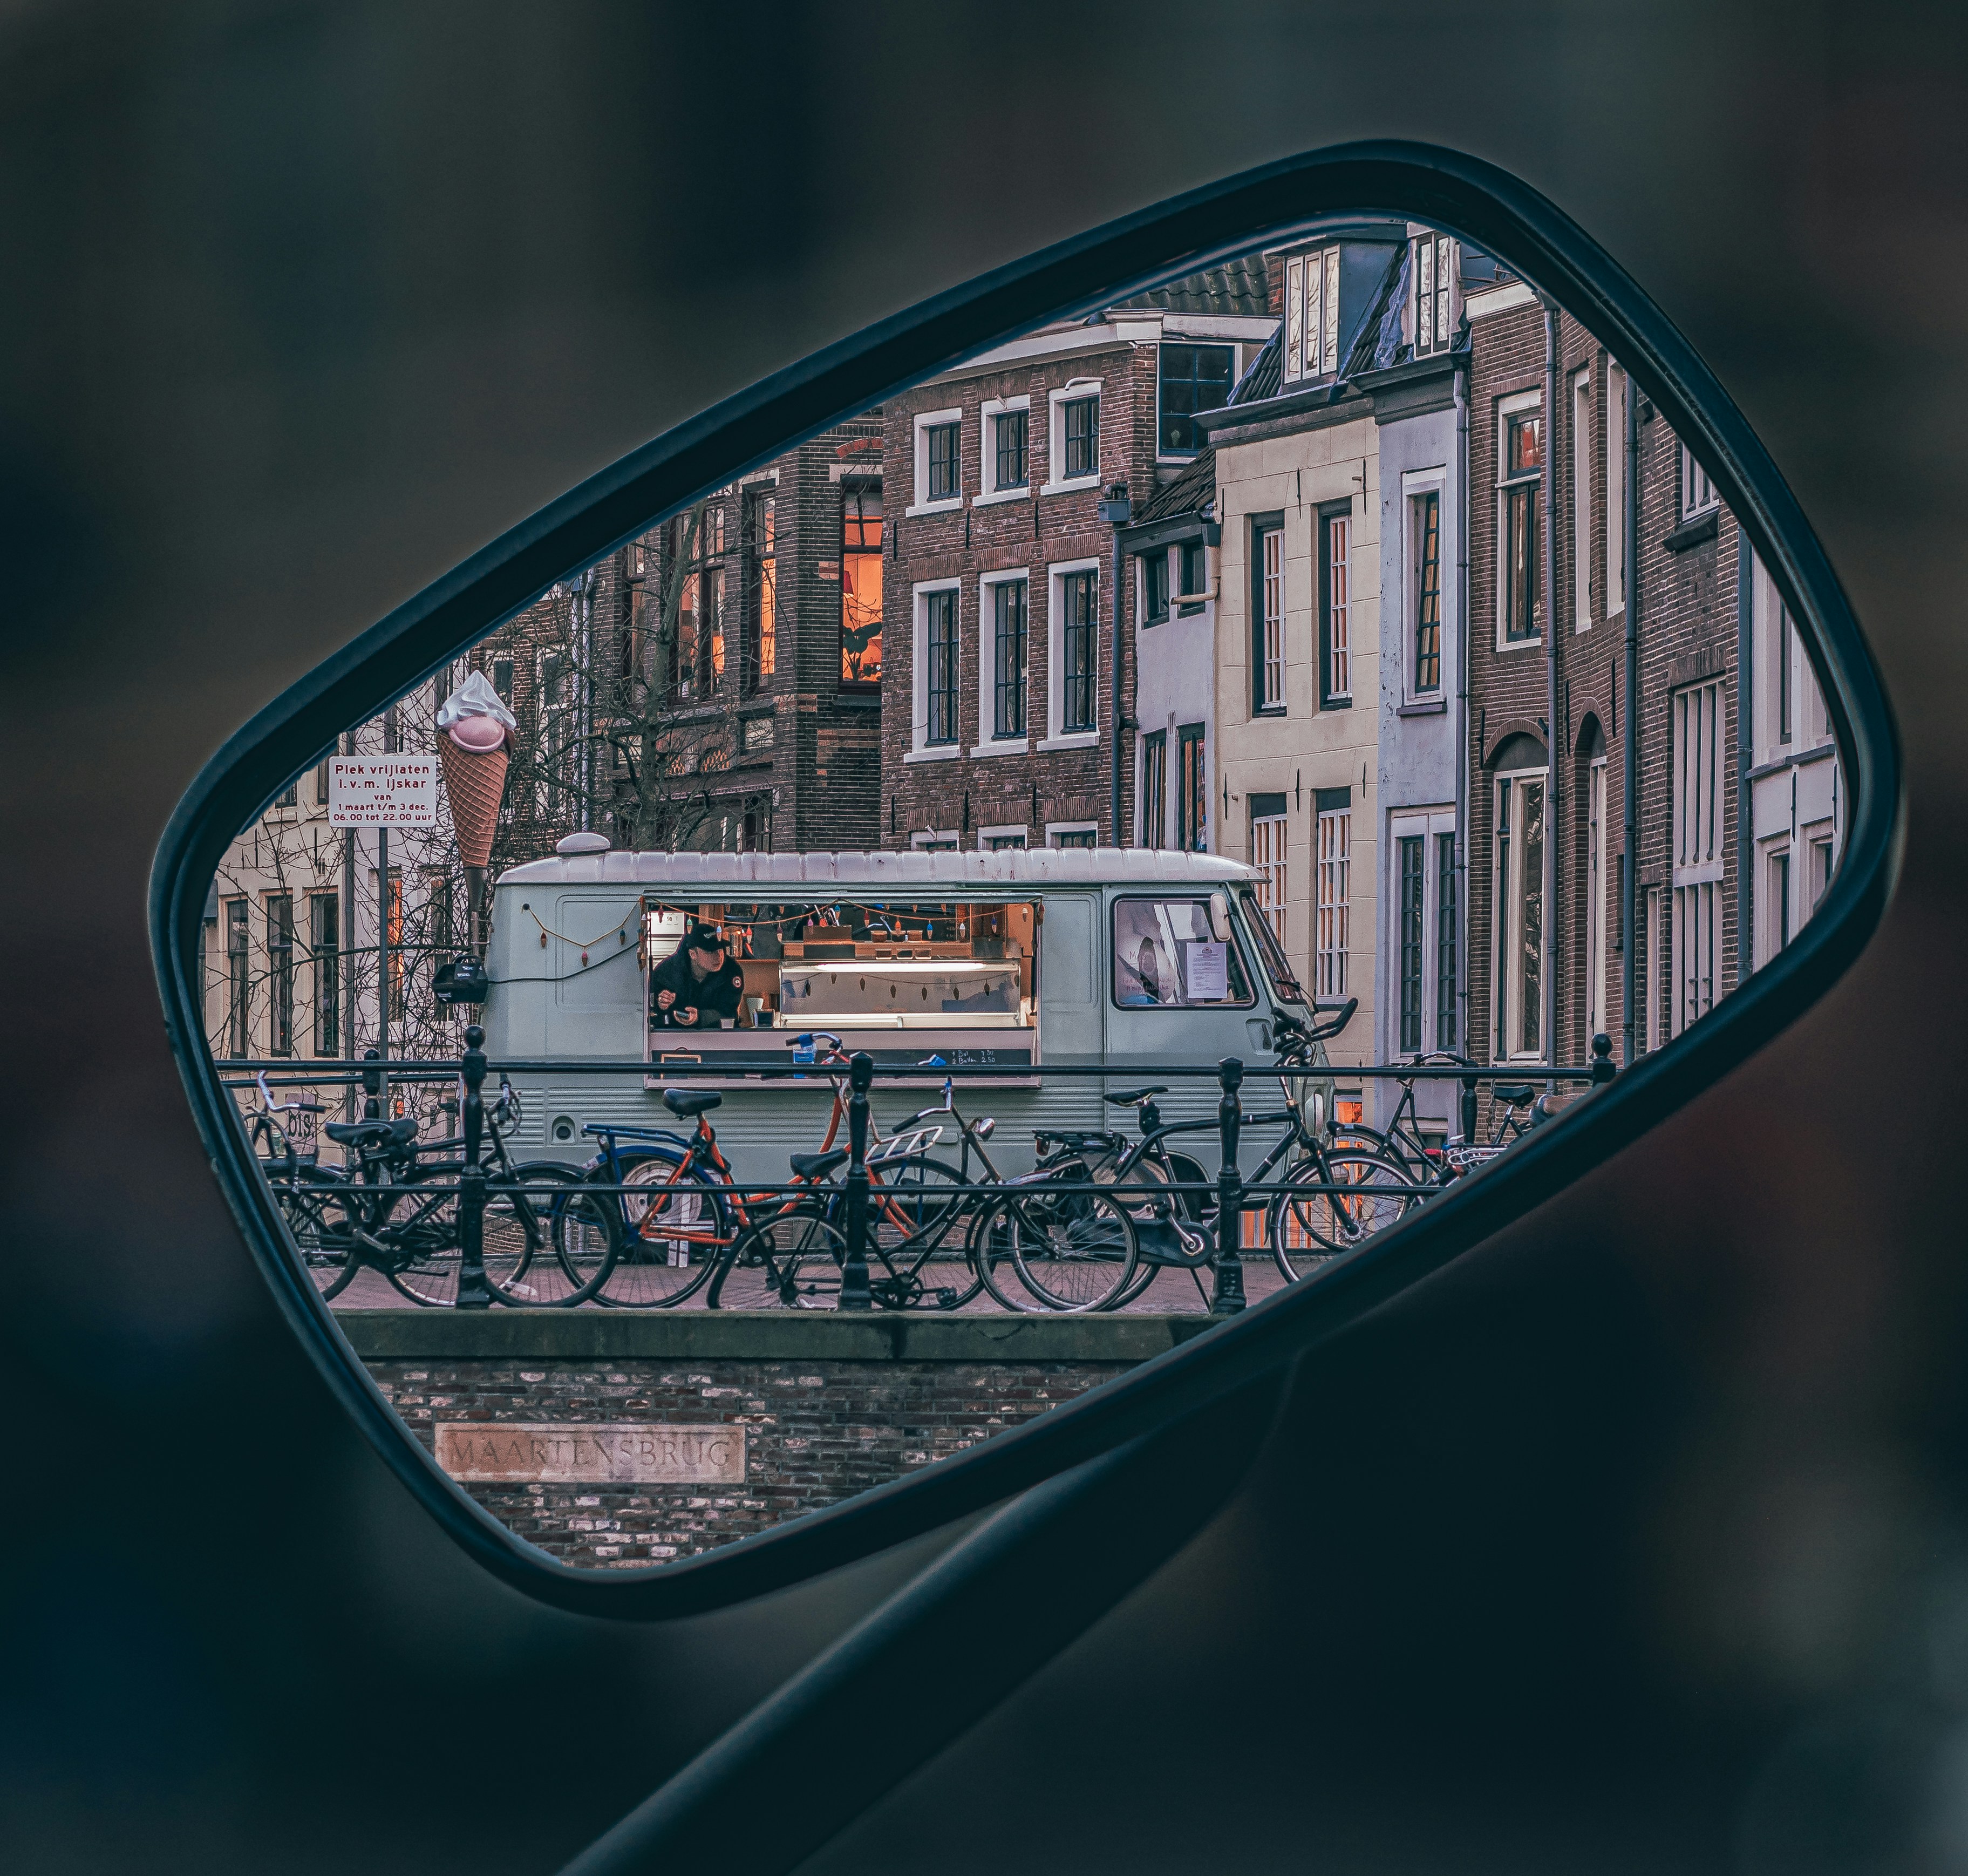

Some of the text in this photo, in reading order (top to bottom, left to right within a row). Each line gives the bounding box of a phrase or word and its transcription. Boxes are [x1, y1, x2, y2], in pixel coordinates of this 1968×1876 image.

[335, 764, 429, 777] Plek vrijlaten
[339, 778, 426, 791] i.v.m. ijskar
[377, 803, 396, 811] t/m
[452, 1439, 731, 1466] MAARTENSBRUG
